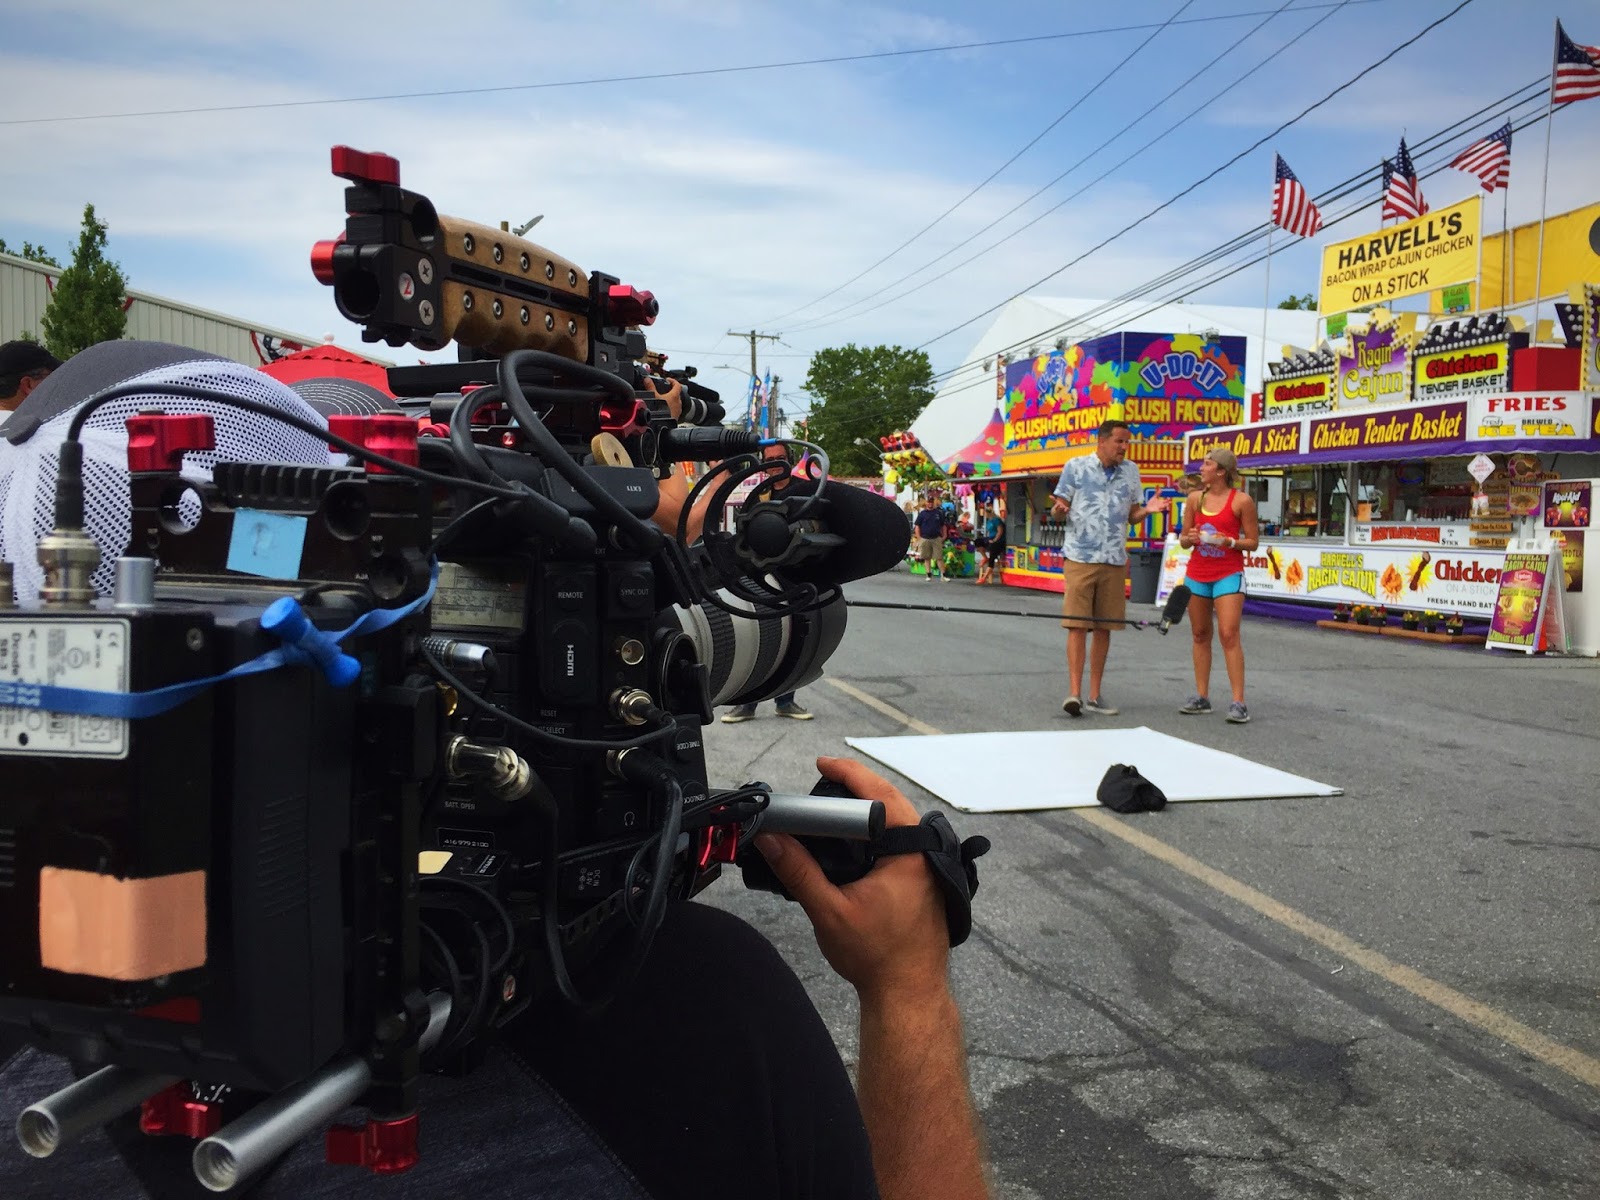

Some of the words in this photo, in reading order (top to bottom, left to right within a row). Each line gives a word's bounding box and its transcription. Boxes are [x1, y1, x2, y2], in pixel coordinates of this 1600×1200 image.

[1338, 212, 1462, 270] HARVELL'S
[1327, 269, 1357, 287] BACON
[1359, 260, 1387, 278] WRAP
[1389, 249, 1422, 269] CAJUN
[1424, 234, 1474, 259] CHICKEN
[1352, 283, 1372, 303] ON
[1374, 281, 1383, 298] A
[1387, 268, 1430, 294] STICK
[1357, 342, 1392, 371] Ragin
[1426, 353, 1498, 379] Chicken
[1274, 382, 1325, 402] Chicken
[1343, 369, 1403, 402] Cajun
[1420, 379, 1459, 394] TENDER
[1462, 373, 1504, 389] BASKET
[1124, 399, 1171, 423] SLUSH
[1175, 399, 1240, 424] FACTORY
[1269, 406, 1283, 416] ON
[1296, 400, 1328, 412] STICK
[1488, 397, 1567, 412] FRIES
[1015, 419, 1049, 440] SLUSH
[1051, 405, 1107, 432] FACTORY
[1313, 422, 1359, 450] Chicken
[1364, 416, 1409, 446] Tender
[1410, 410, 1462, 441] Basket
[1478, 425, 1516, 437] ICE
[1522, 424, 1576, 436] TEA
[1234, 432, 1250, 456] On
[1252, 430, 1263, 454] A
[1264, 428, 1298, 453] Stick
[1320, 552, 1364, 568] HARVELL'S
[620, 588, 636, 596] SYNC
[637, 588, 649, 596] OUT
[1307, 566, 1340, 593] RAGIN
[1342, 567, 1378, 599] CAJUN
[1446, 584, 1459, 593] ON
[1462, 584, 1468, 592] A
[1469, 585, 1495, 595] STICK
[557, 591, 584, 599] REMOTE
[1427, 597, 1449, 605] FRESH
[1457, 600, 1477, 608] HAND
[566, 644, 574, 677] HDMI
[540, 709, 557, 717] RESET
[676, 742, 689, 750] CODE
[689, 740, 701, 748] TIME
[444, 801, 459, 809] BATT.
[460, 802, 476, 810] OPEN
[683, 793, 706, 804] GENLOCK
